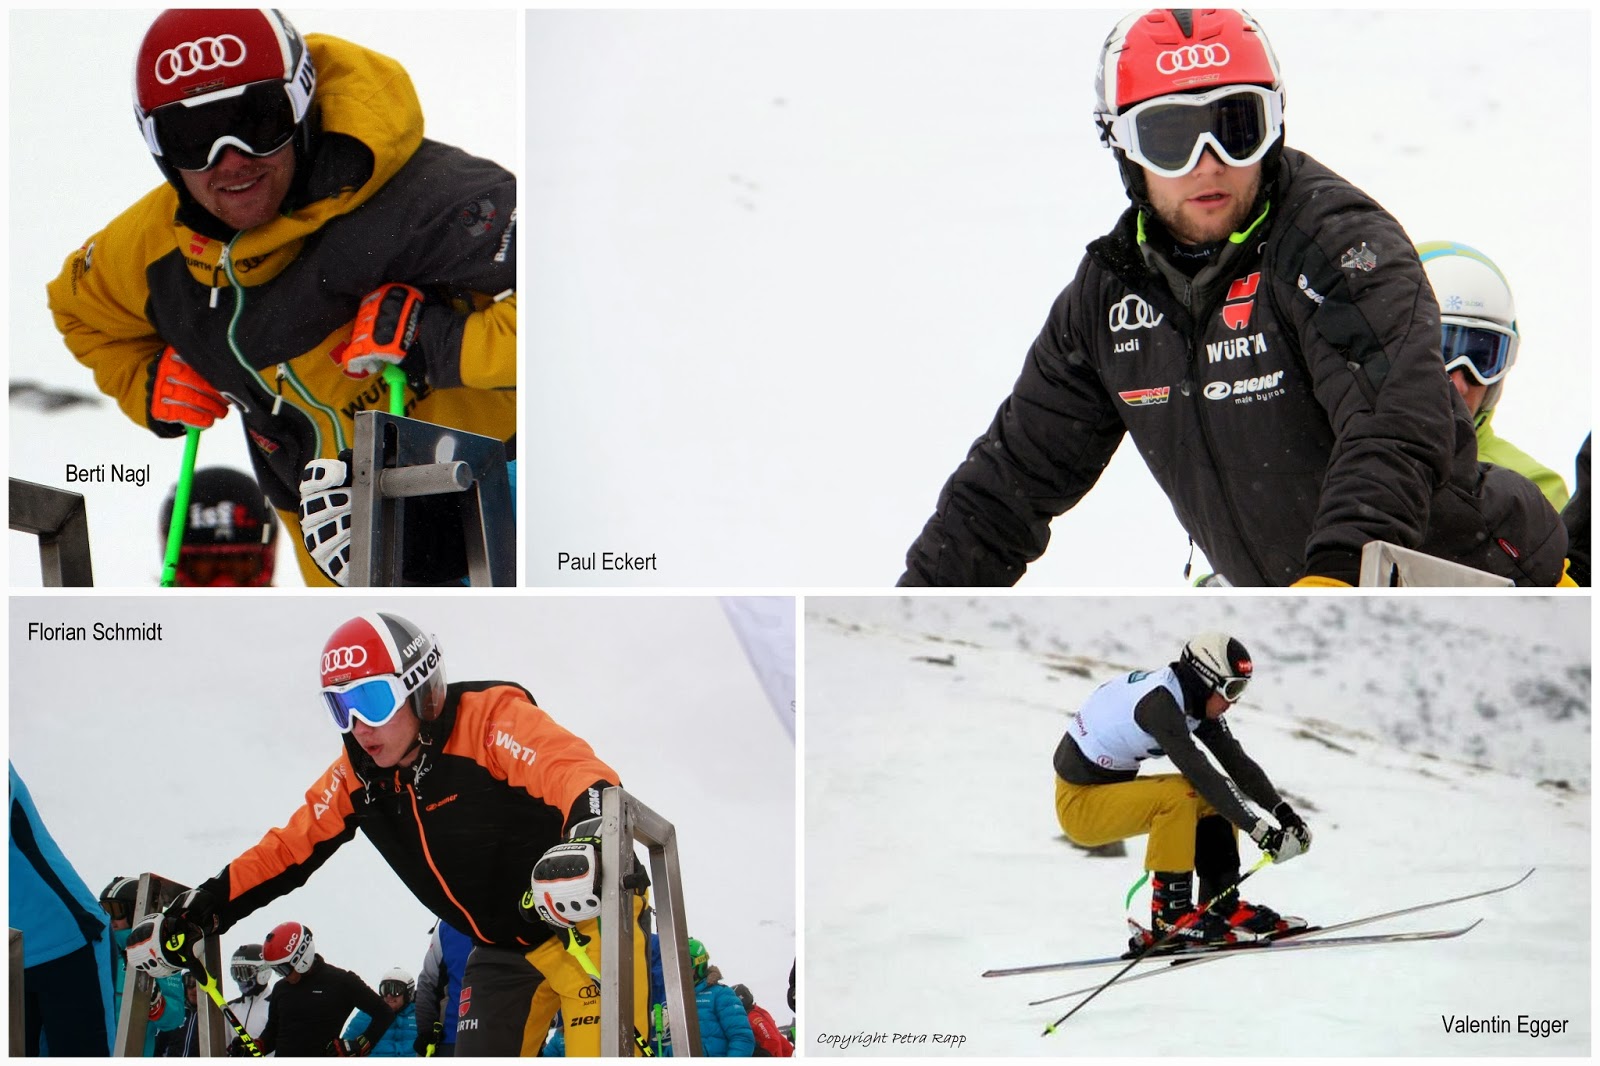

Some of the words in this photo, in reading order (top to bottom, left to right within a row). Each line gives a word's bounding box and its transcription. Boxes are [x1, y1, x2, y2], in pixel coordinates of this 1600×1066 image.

[1113, 338, 1140, 354] udi
[402, 633, 427, 658] uvex
[402, 643, 442, 691] uvex
